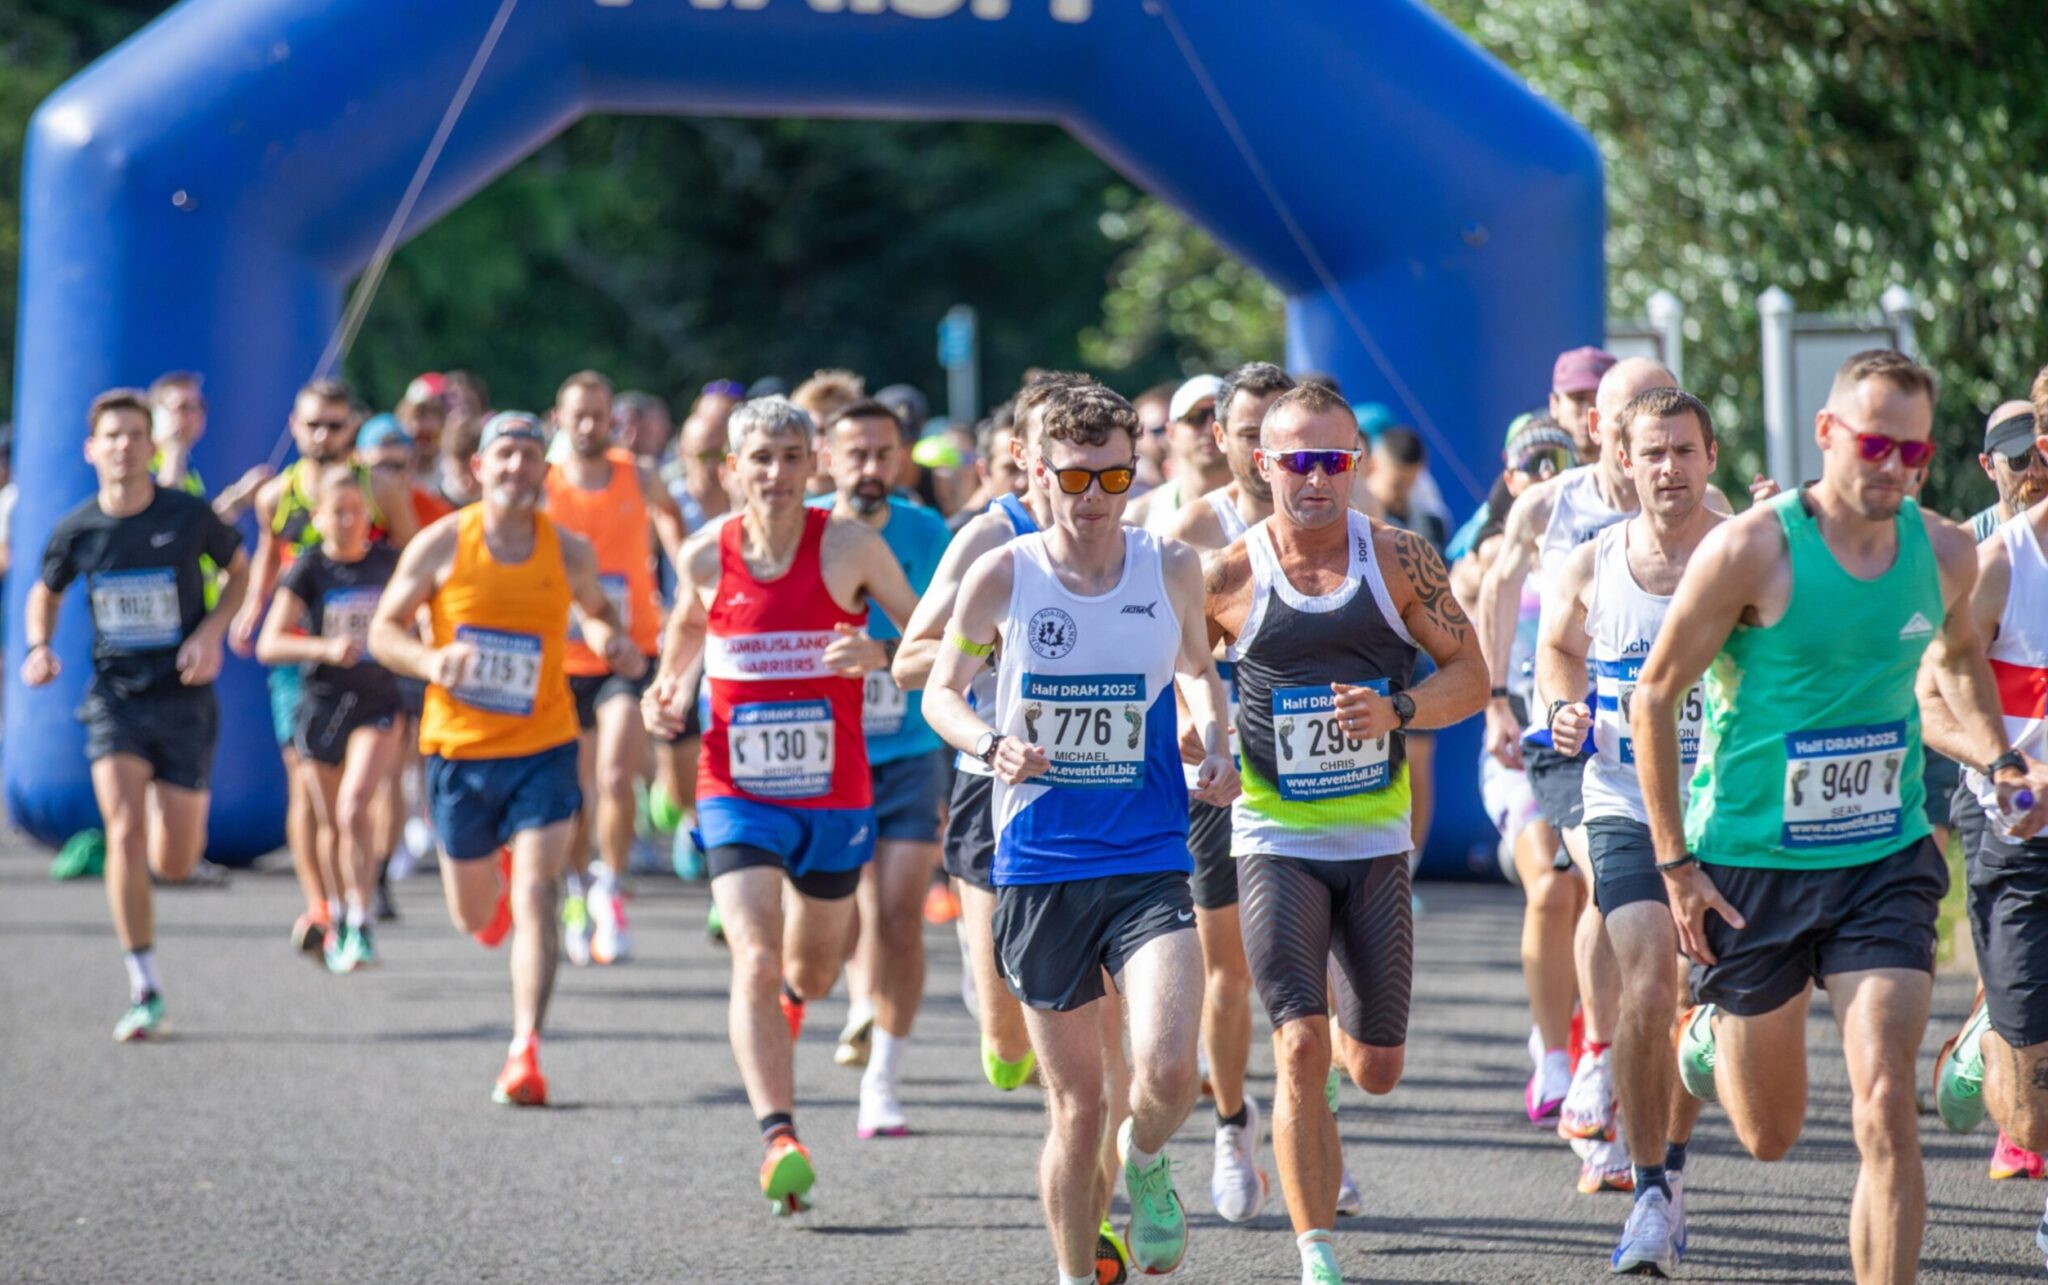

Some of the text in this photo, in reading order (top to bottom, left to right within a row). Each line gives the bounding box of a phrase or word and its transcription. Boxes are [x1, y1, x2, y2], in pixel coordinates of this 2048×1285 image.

[1030, 609, 1075, 653] DUNDEE ROADRUNNERS
[1032, 683, 1136, 697] Half DRAM 2025
[1282, 696, 1336, 711] Half DRA
[1054, 707, 1112, 746] 776
[760, 729, 806, 762] 130
[1795, 731, 1898, 754] Half DRAM 2025
[1054, 751, 1110, 762] MICHAEL
[1320, 758, 1356, 772] CHRIS
[1049, 763, 1137, 776] w.eventfull.biz
[1286, 764, 1384, 788] www.eventfull.biz
[1821, 758, 1872, 802] 940
[1830, 804, 1862, 818] SEAN
